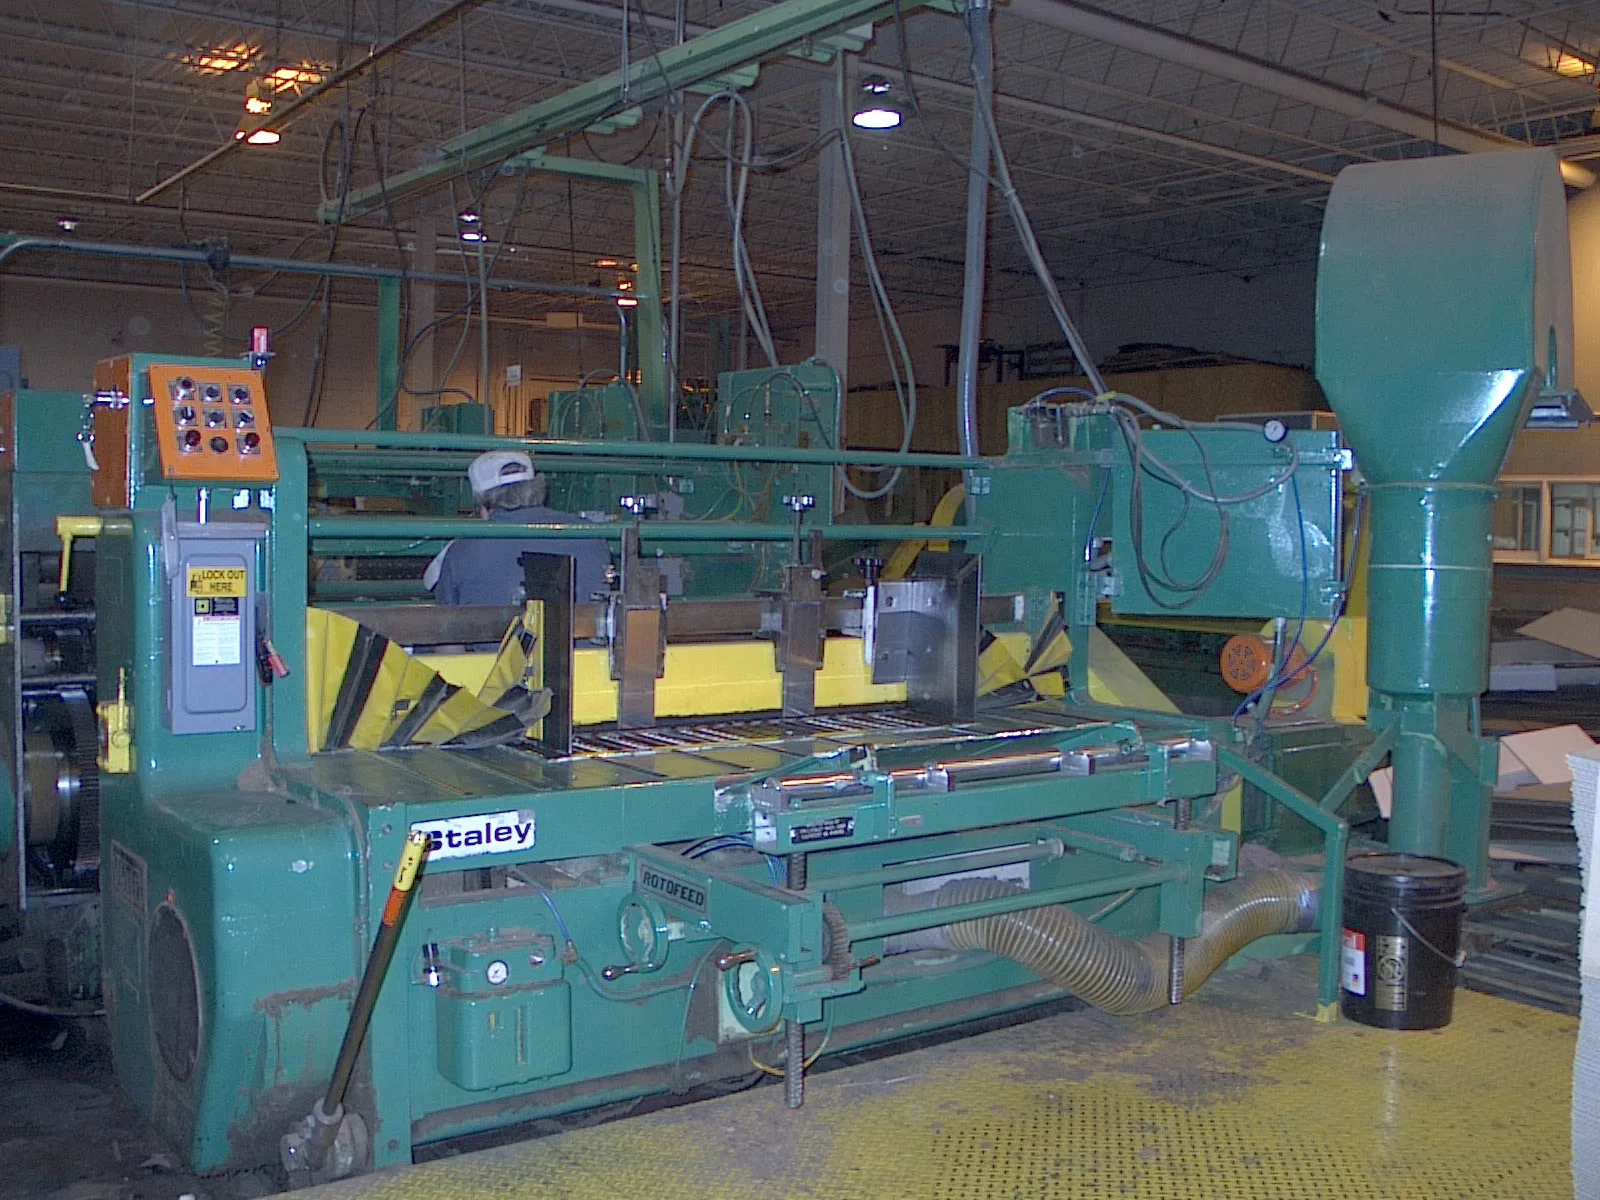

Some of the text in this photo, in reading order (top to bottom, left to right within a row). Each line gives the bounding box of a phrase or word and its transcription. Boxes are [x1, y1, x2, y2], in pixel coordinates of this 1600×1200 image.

[202, 570, 245, 579] LOCK OUT
[210, 582, 233, 592] HERE
[643, 871, 704, 906] ROTOFEED
